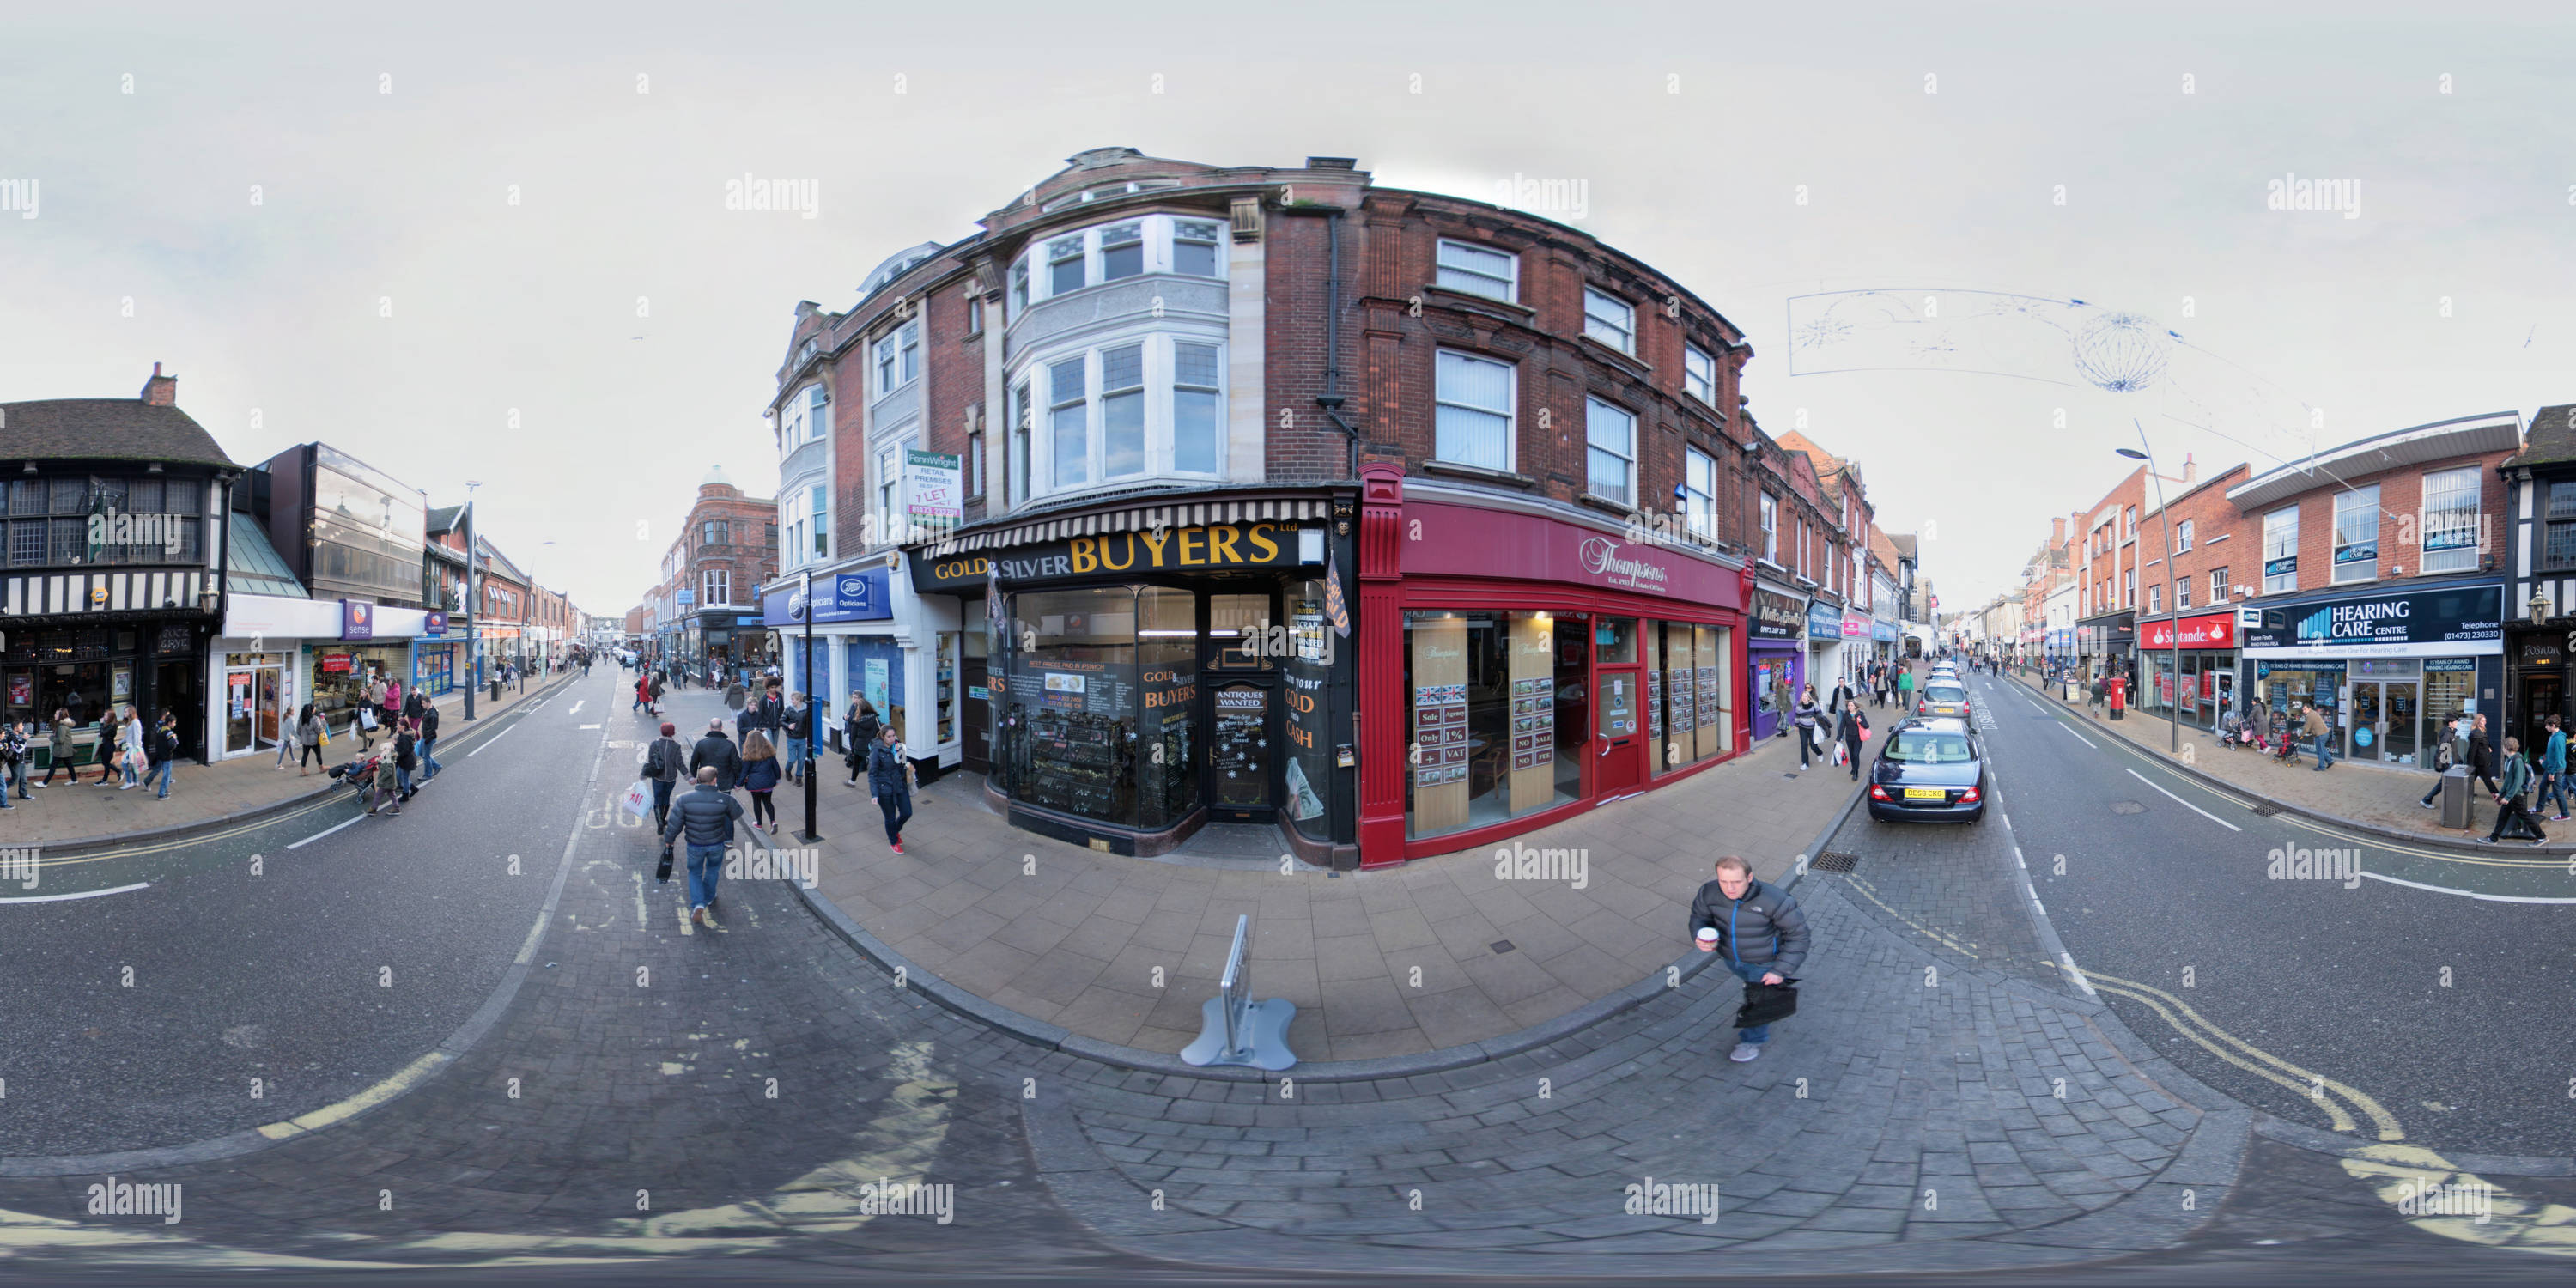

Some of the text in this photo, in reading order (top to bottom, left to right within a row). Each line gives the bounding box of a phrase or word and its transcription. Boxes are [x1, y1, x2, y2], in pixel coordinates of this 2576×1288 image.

[908, 453, 957, 467] FennWright
[914, 475, 952, 485] PREMISES
[924, 489, 946, 502] LET
[935, 523, 1297, 579] GOLD & SILVER BUYERS Ltd
[2349, 544, 2375, 554] HEARING
[1580, 537, 1666, 587] Thompsons
[840, 599, 866, 608] Opticians
[2332, 601, 2409, 622] HEARING
[349, 625, 369, 634] sense
[2332, 621, 2407, 637] CARE CENTRE
[2461, 621, 2499, 630] Telephone
[2165, 627, 2207, 642] Satande
[2444, 630, 2499, 641] (01473) 230330
[1143, 670, 1173, 682] GOLD
[1296, 677, 1322, 691] your
[1145, 685, 1195, 708] BUYERS
[1285, 689, 1315, 713] GOLD
[1422, 713, 1438, 721] Sole
[1286, 720, 1312, 749] CASH
[1420, 730, 1463, 744] Only 1%
[1535, 735, 1552, 744] SALE
[1446, 749, 1465, 757] VAT
